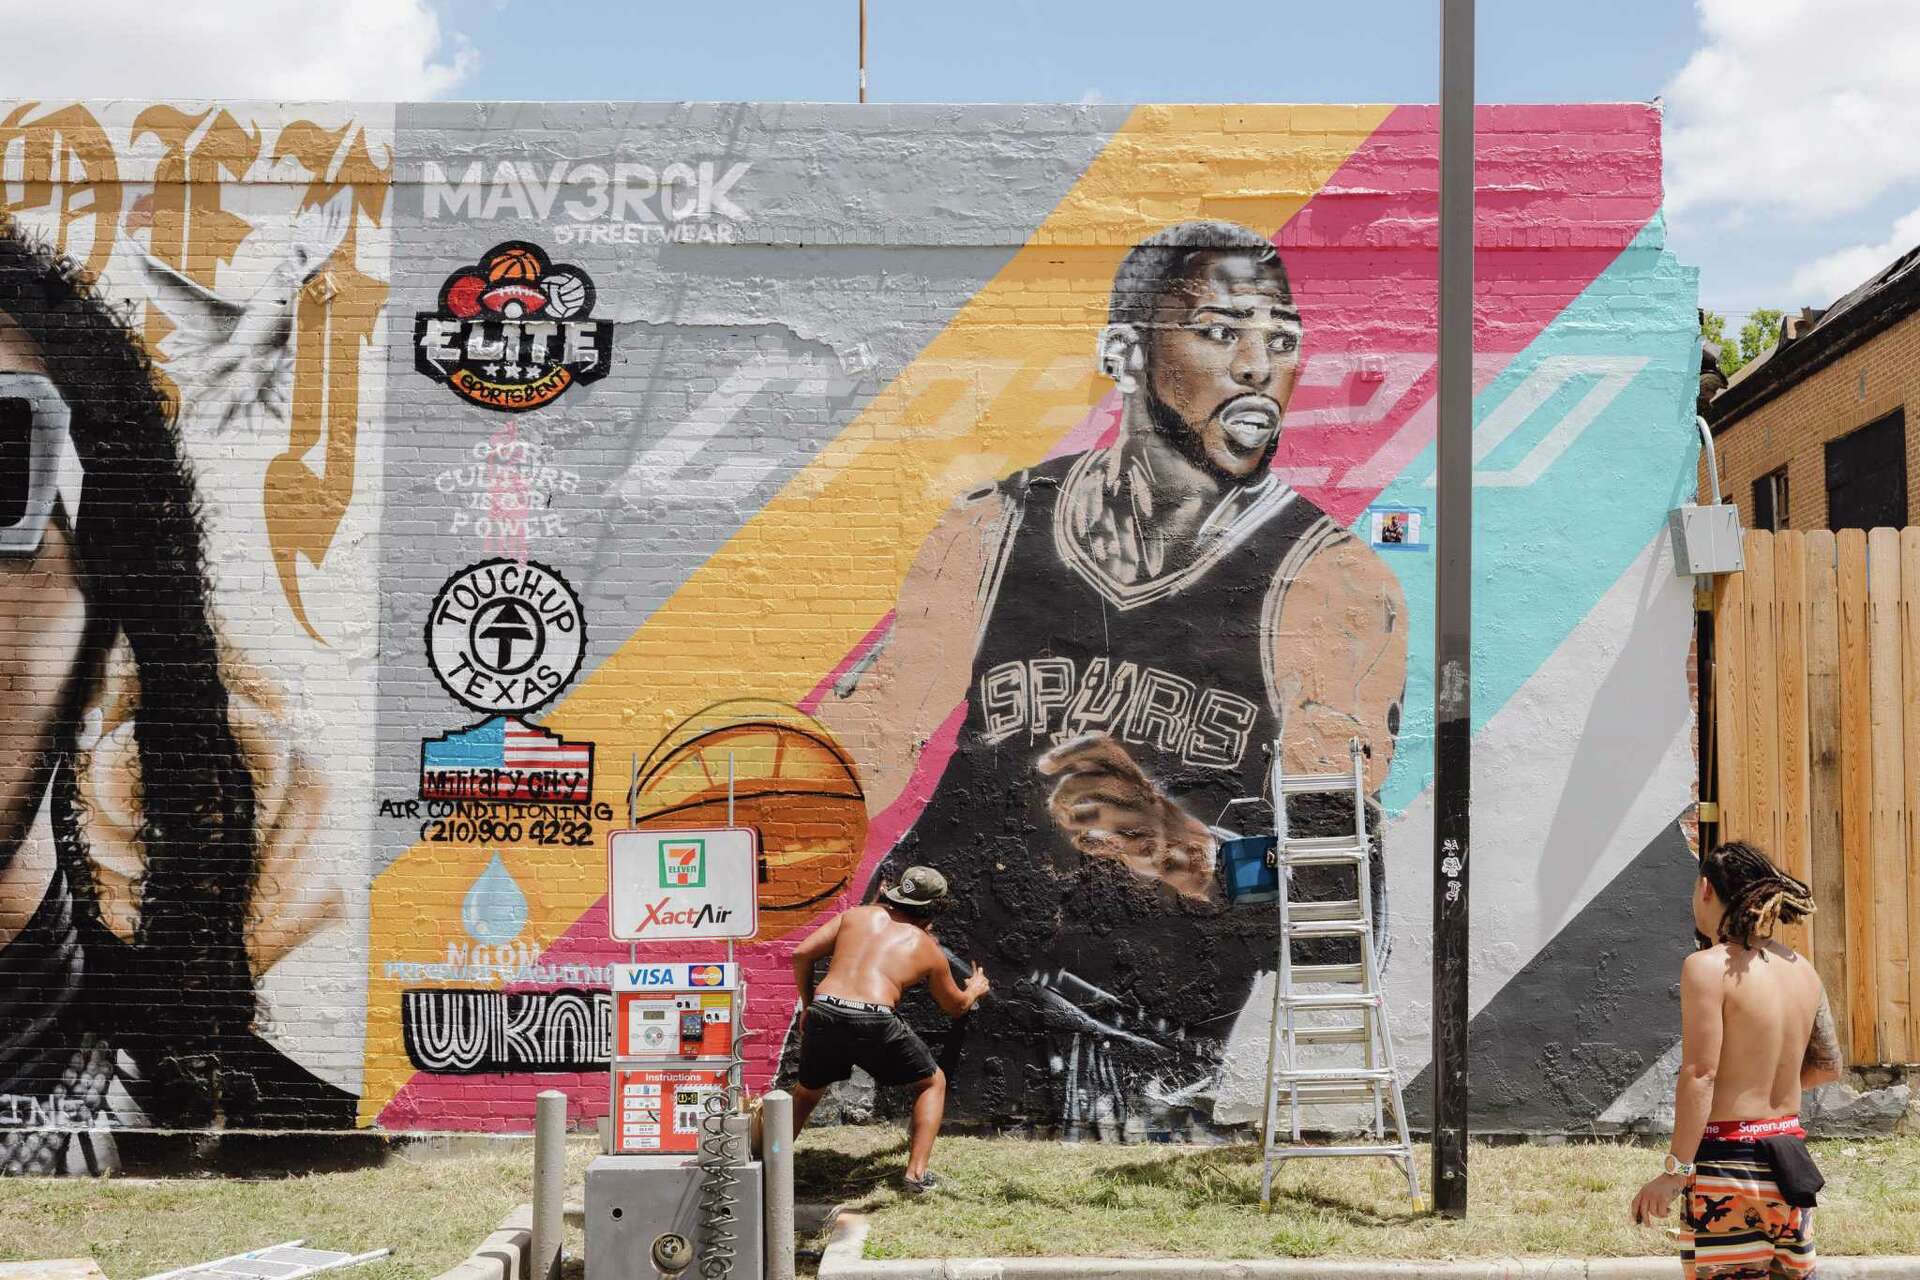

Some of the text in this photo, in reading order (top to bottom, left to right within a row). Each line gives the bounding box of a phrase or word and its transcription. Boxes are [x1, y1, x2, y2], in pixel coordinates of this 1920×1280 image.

[420, 319, 599, 372] ELITE
[450, 511, 569, 537] POWER
[437, 566, 575, 633] TOUCH-UP
[448, 651, 562, 704] TEXAS
[981, 656, 1259, 769] SPURS
[379, 799, 613, 821] AIR CONDITIONING
[420, 820, 594, 845] (210)900 4232
[635, 897, 732, 932] XactAir
[628, 968, 674, 985] VISA
[645, 1072, 702, 1081] Instructions
